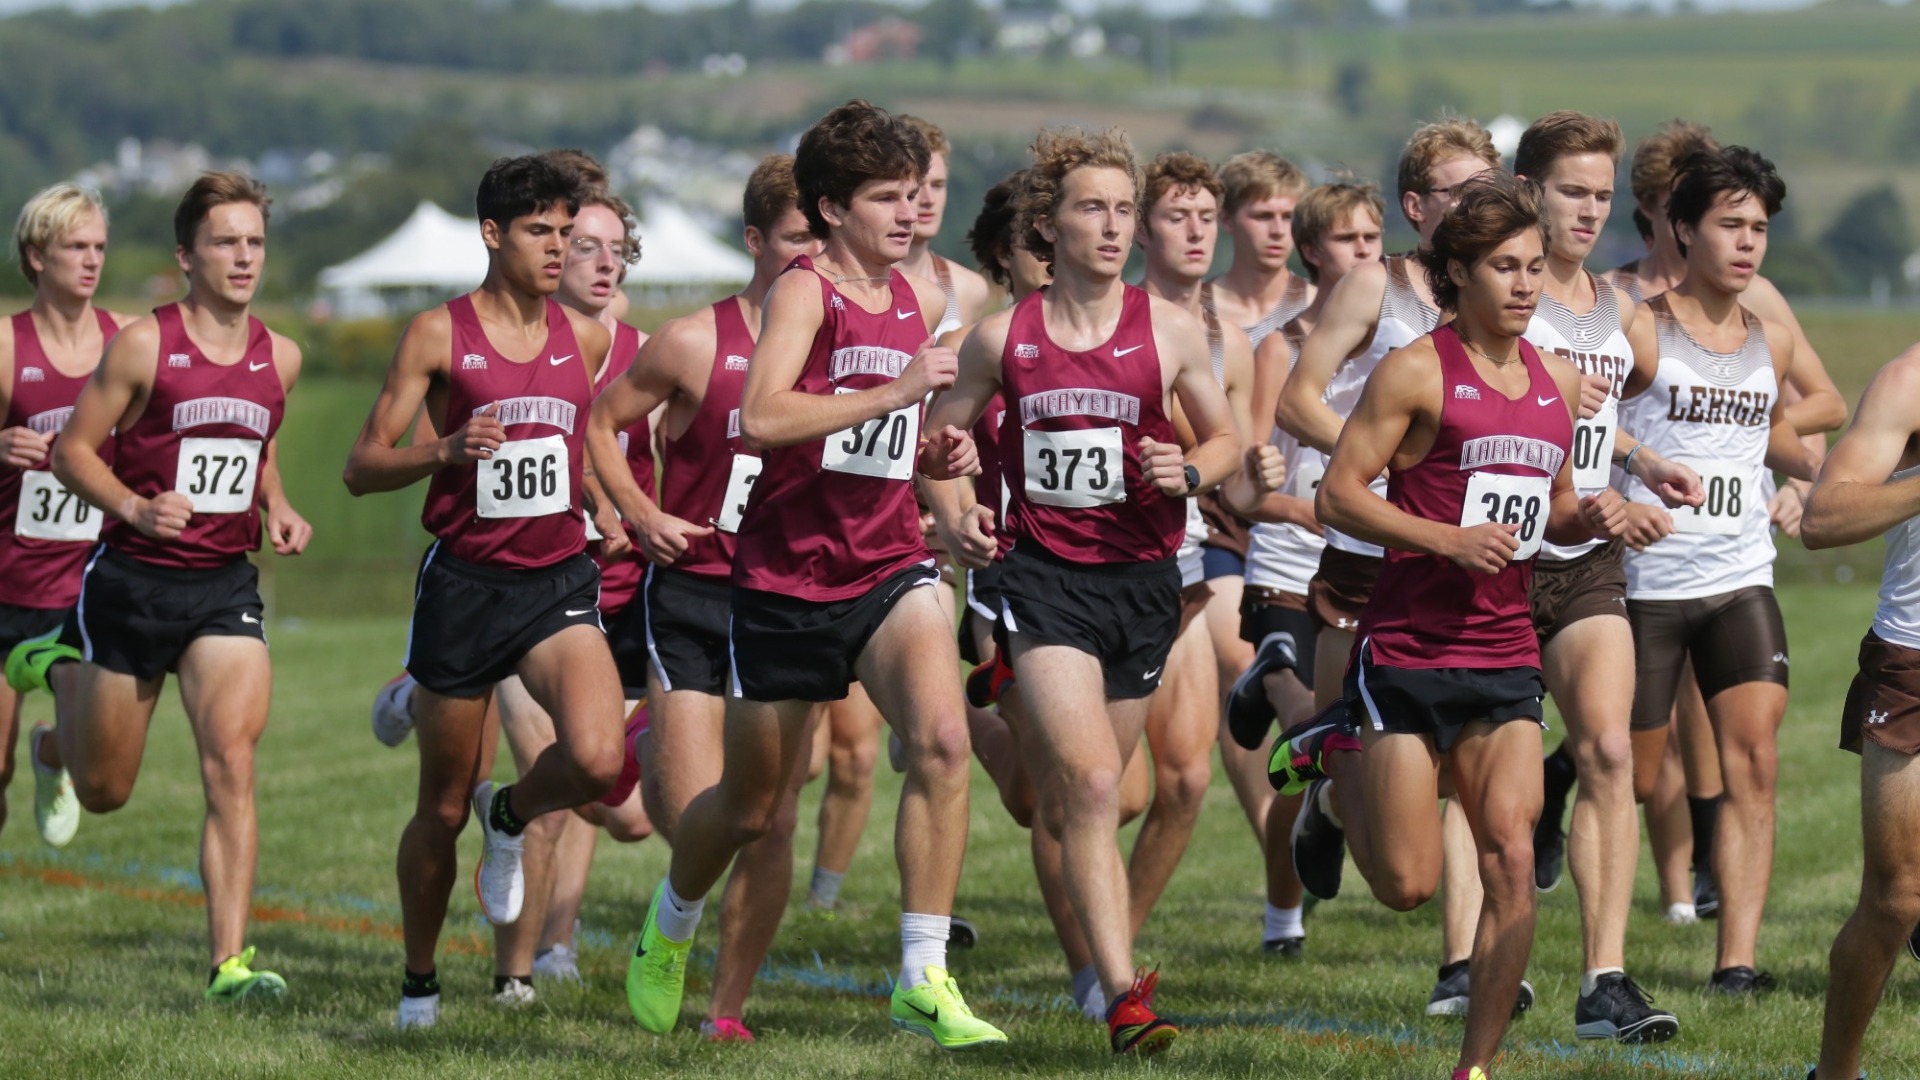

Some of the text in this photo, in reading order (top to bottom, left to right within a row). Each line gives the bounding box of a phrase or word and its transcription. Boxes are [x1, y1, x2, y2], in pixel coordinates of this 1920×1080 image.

[830, 346, 914, 380] LAFAYET
[1536, 346, 1626, 400] HIGH
[172, 397, 271, 437] LAFAYETTE
[473, 396, 577, 435] FAYETTE
[1020, 388, 1140, 425] LAFAYETTE
[1667, 385, 1769, 427] LEHIGH
[841, 411, 908, 461] 370
[1460, 435, 1565, 479] LAFAYETTE
[189, 455, 248, 495] 372
[492, 453, 556, 501] 366
[1038, 446, 1109, 491] 373
[1481, 492, 1541, 542] 368
[1693, 475, 1742, 518] 08
